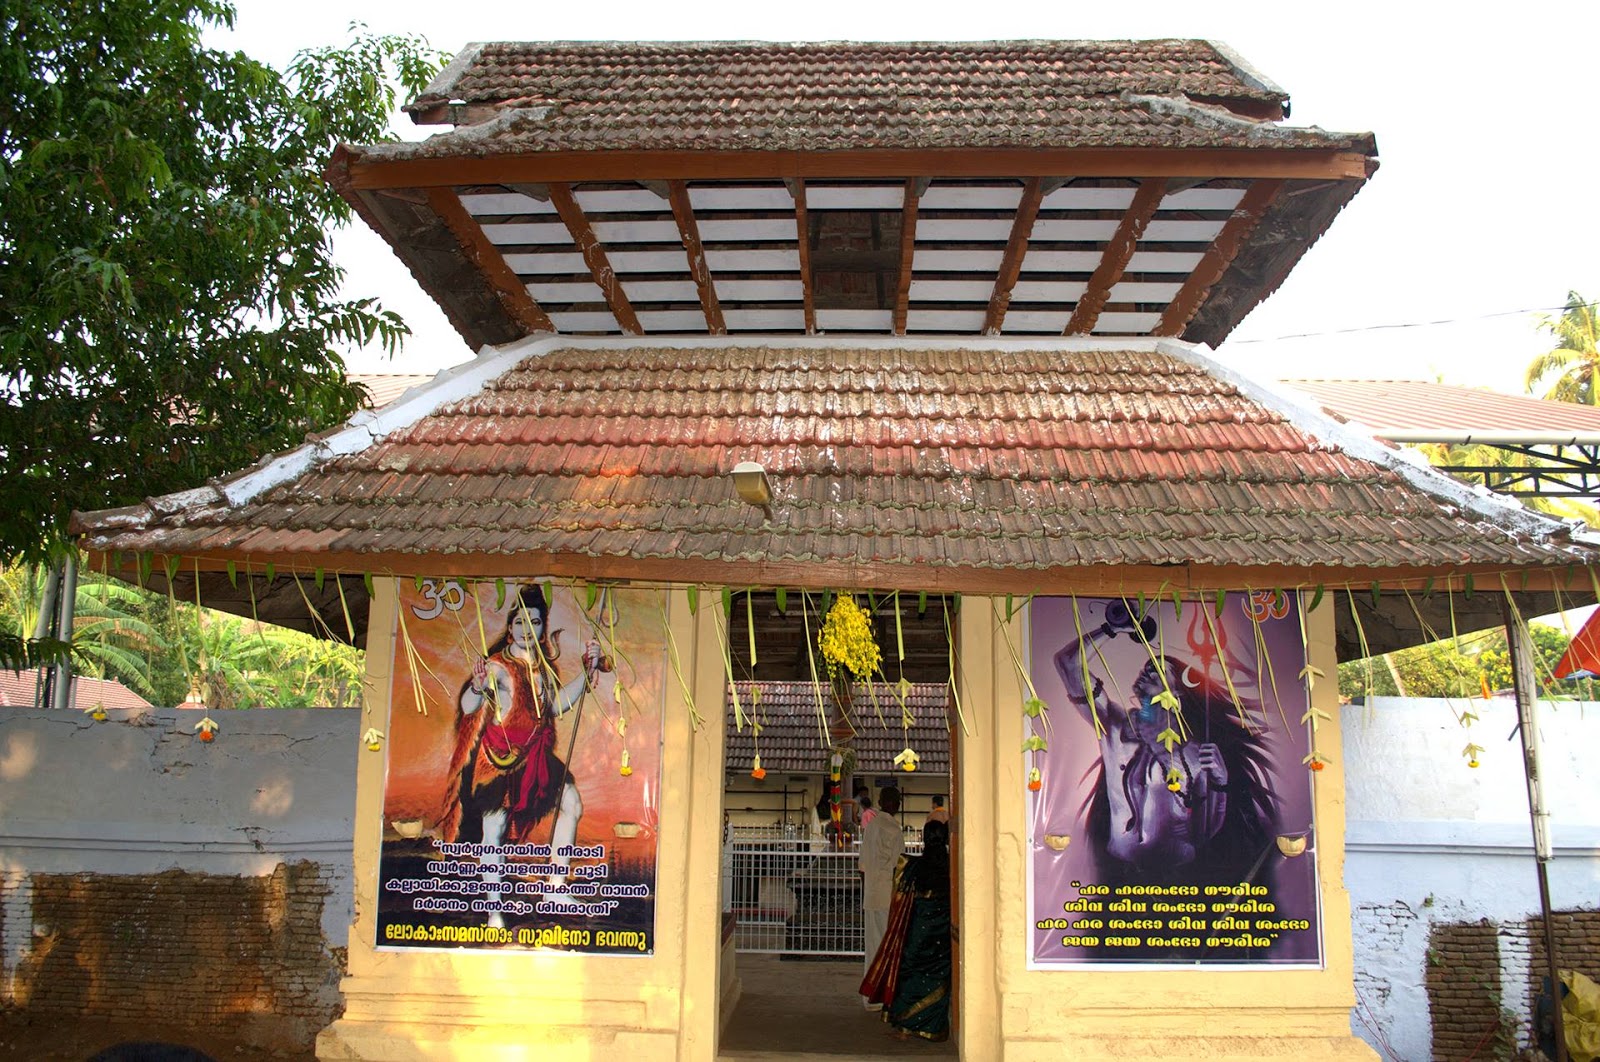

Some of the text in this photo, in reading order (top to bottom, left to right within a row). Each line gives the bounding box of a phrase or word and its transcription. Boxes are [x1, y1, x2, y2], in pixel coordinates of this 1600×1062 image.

[557, 844, 604, 858] നീരാടി
[574, 865, 608, 880] ചൂടി
[413, 897, 468, 911] ദർശനം
[472, 898, 533, 914] നൽകും
[1064, 898, 1103, 913] ശിവ
[1108, 899, 1147, 913] ശിവ
[1152, 902, 1206, 913] ശംഭോ
[1109, 918, 1163, 930] ശംഭോ
[1168, 916, 1206, 930] ശിവ
[1212, 916, 1250, 930] ശിവ
[1256, 918, 1310, 931] ശംഭോ
[518, 925, 590, 949] സുഖിനോ
[1062, 935, 1100, 947] ജയ
[1104, 935, 1142, 947] ജയ
[1146, 936, 1201, 948] ശംഭോ
